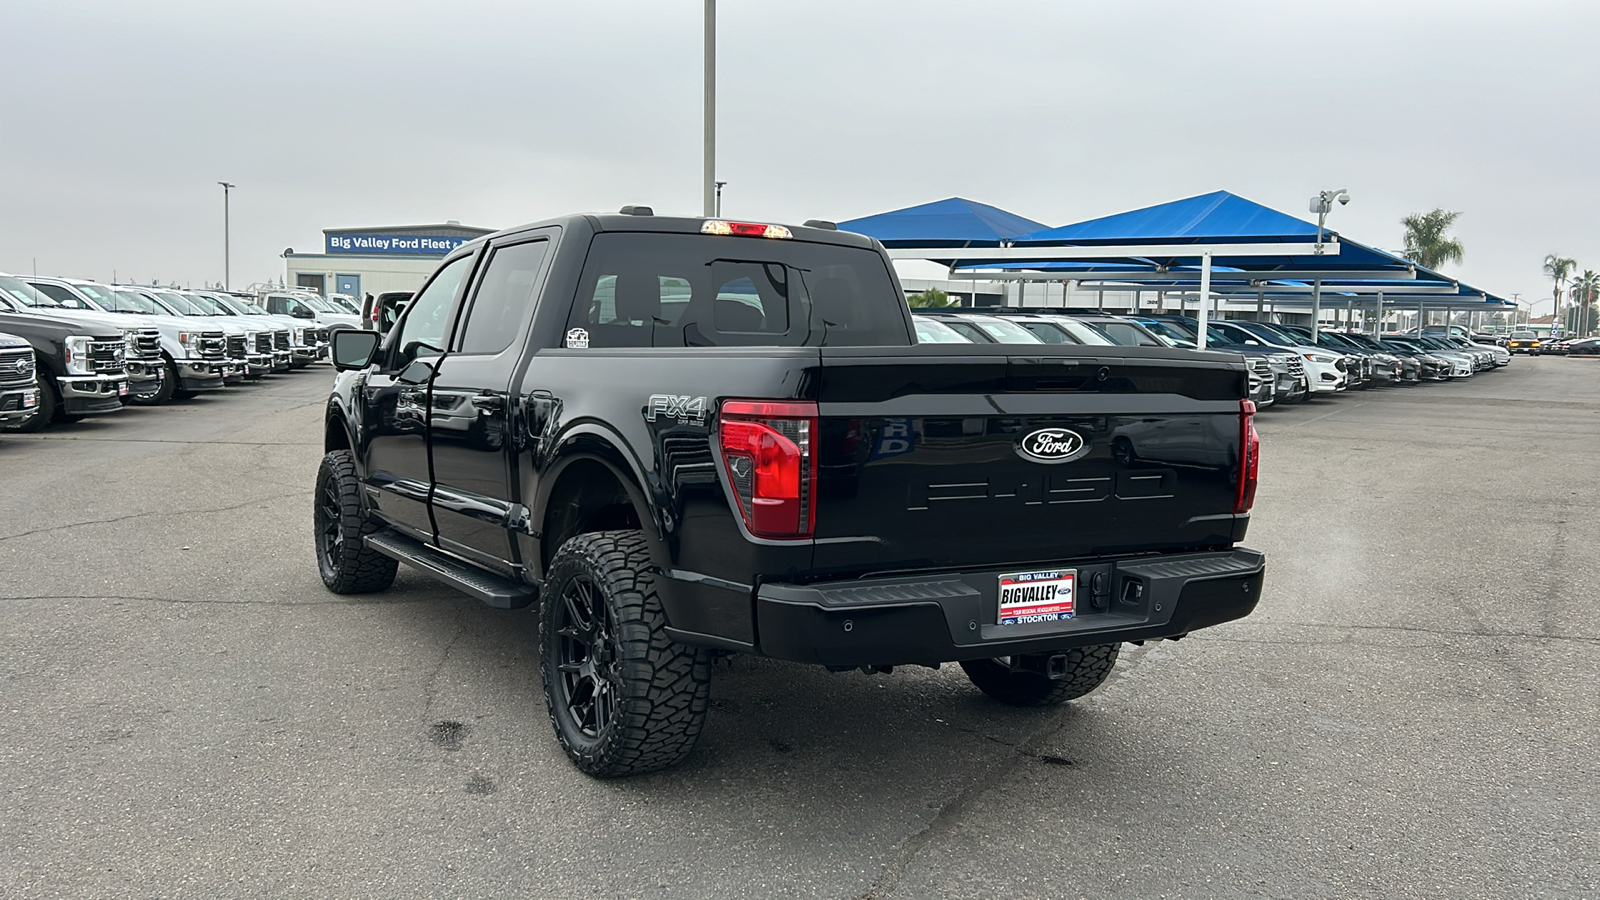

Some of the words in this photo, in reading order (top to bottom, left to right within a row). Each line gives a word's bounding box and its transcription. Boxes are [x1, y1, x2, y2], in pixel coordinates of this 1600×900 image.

[331, 237, 351, 249] Big
[353, 237, 390, 249] Valley
[392, 238, 419, 249] Ford
[421, 238, 450, 249] Fleet
[647, 394, 707, 422] FX4
[1033, 432, 1073, 453] Ford
[1001, 585, 1058, 604] BIGVALLEY
[1017, 614, 1058, 624] STOCKTON
